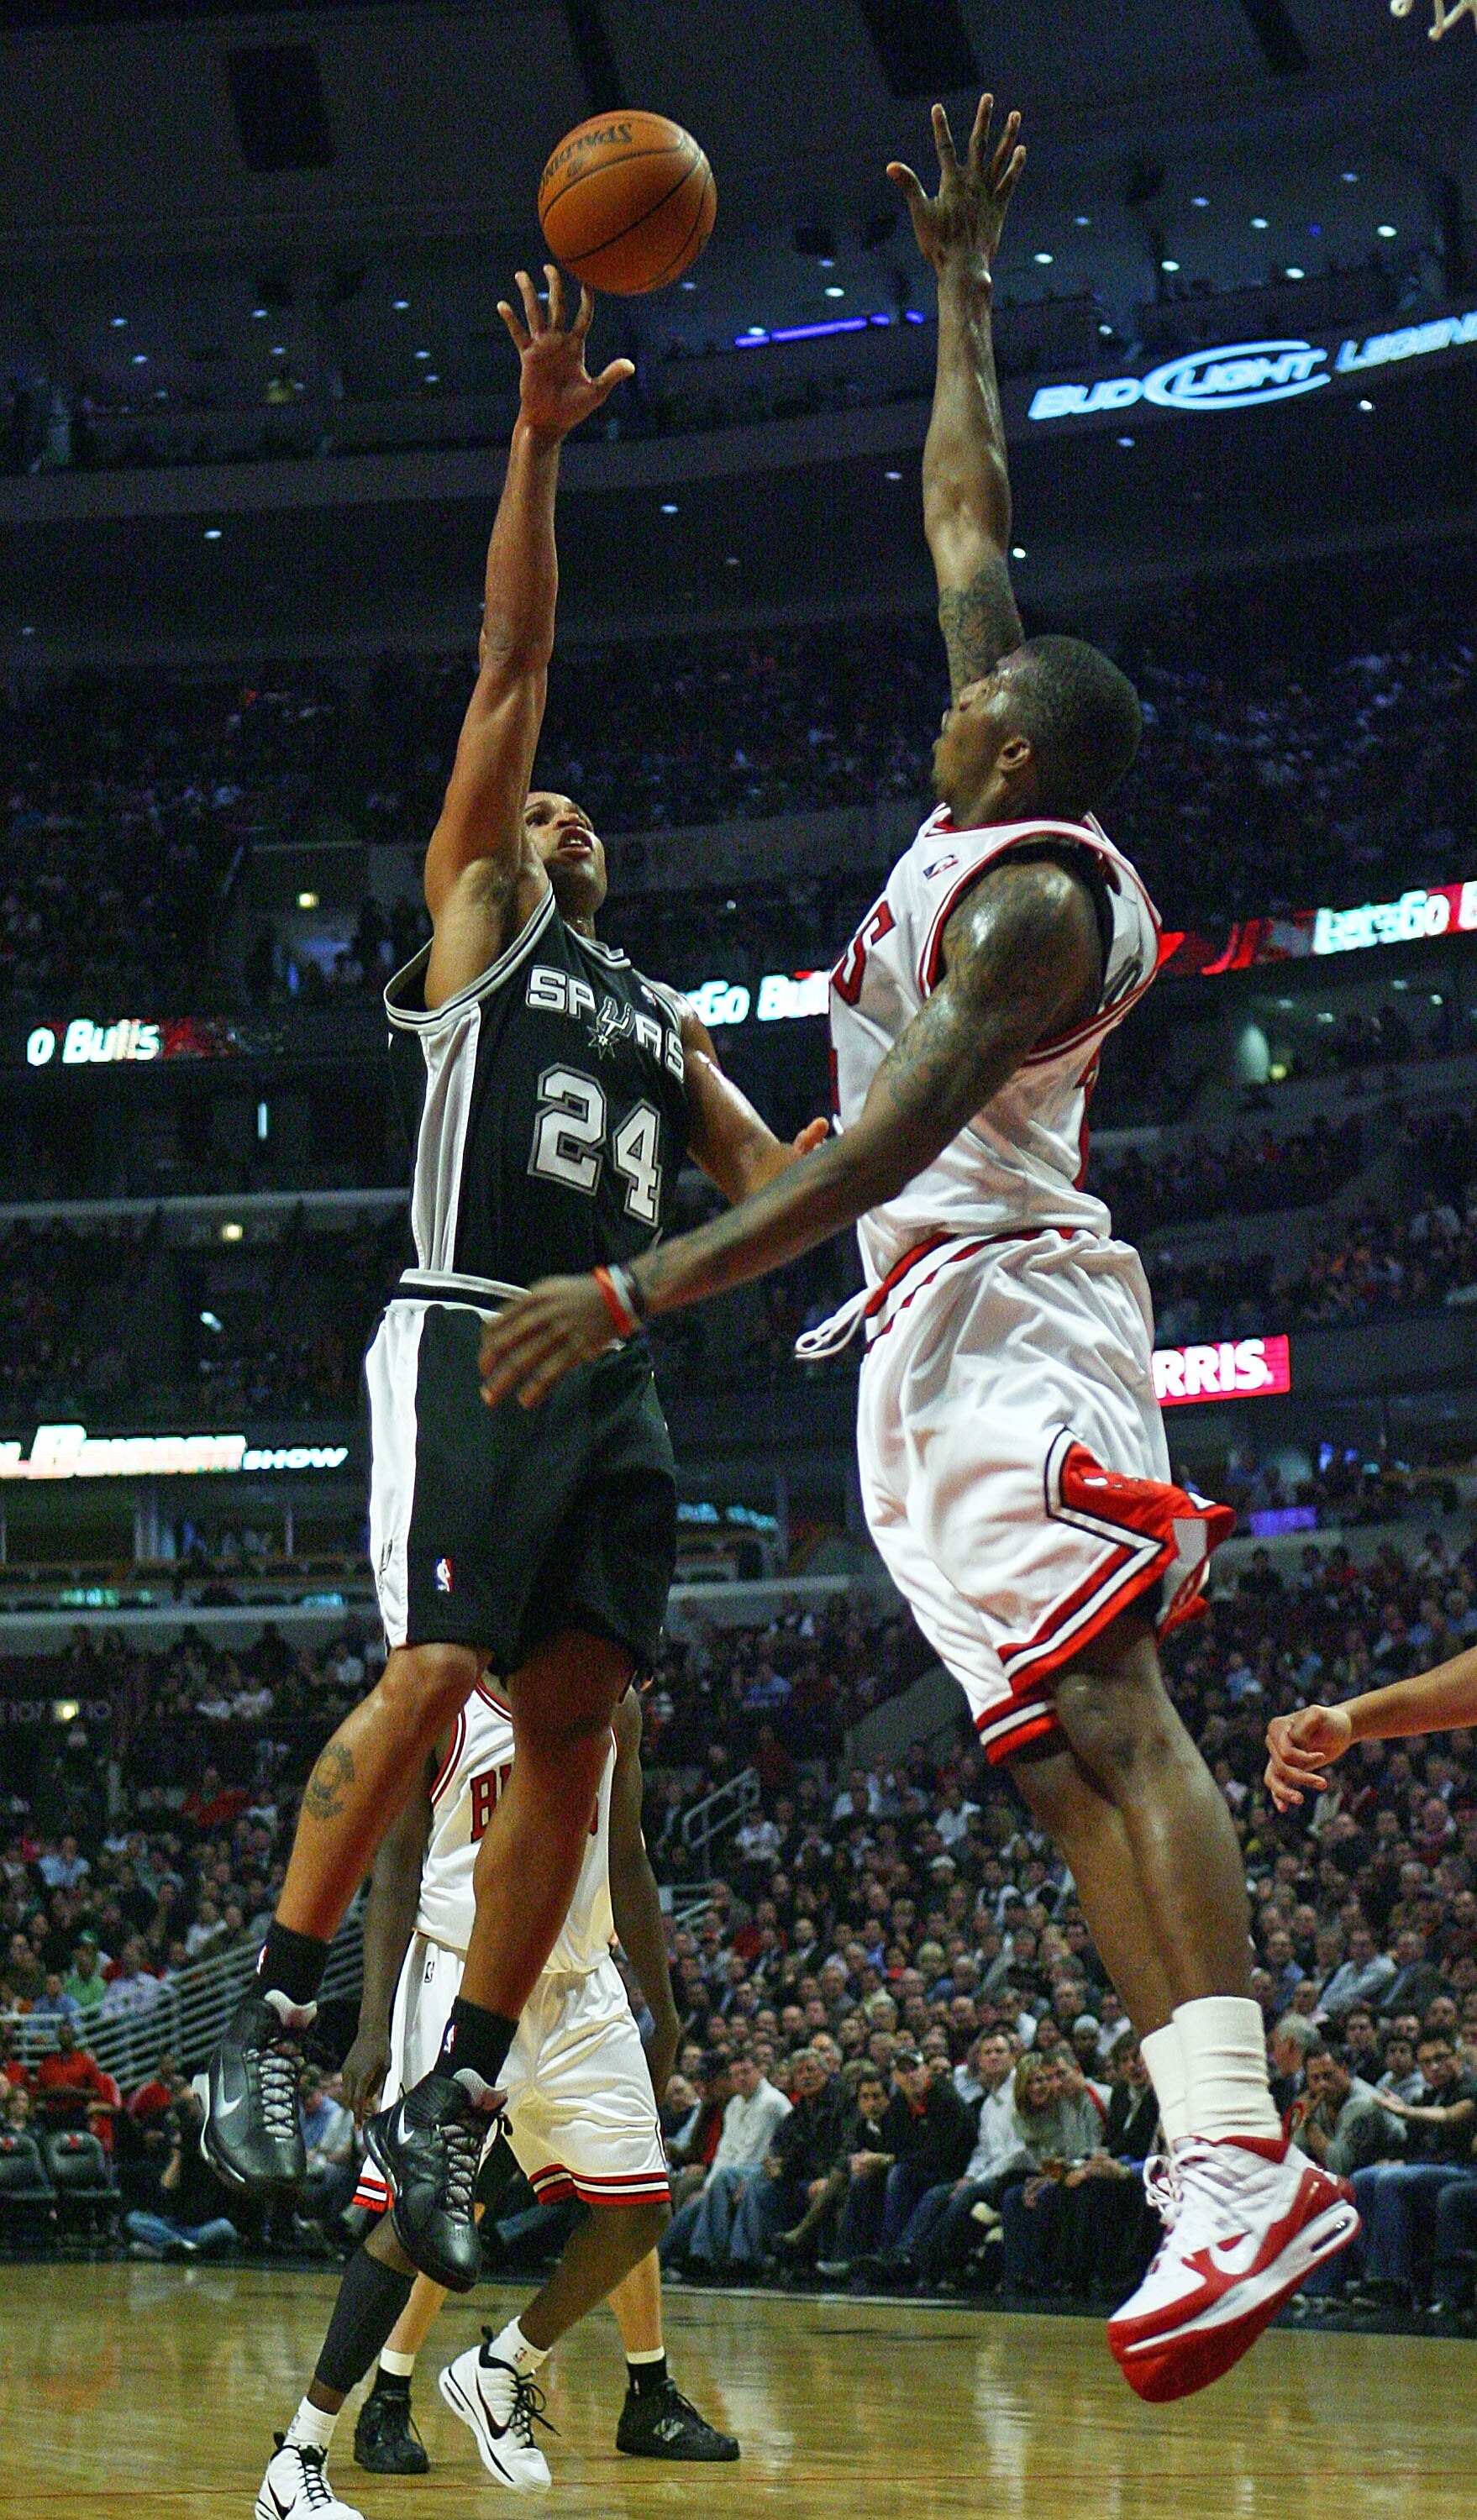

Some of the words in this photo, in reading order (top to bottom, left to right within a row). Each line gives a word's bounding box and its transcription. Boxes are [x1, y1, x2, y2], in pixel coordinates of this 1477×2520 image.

[1028, 378, 1141, 420] BUD
[1170, 348, 1328, 396] LIGHT
[62, 1019, 160, 1063] Bulls
[525, 965, 685, 1084] SPURS
[527, 1062, 662, 1227] 24
